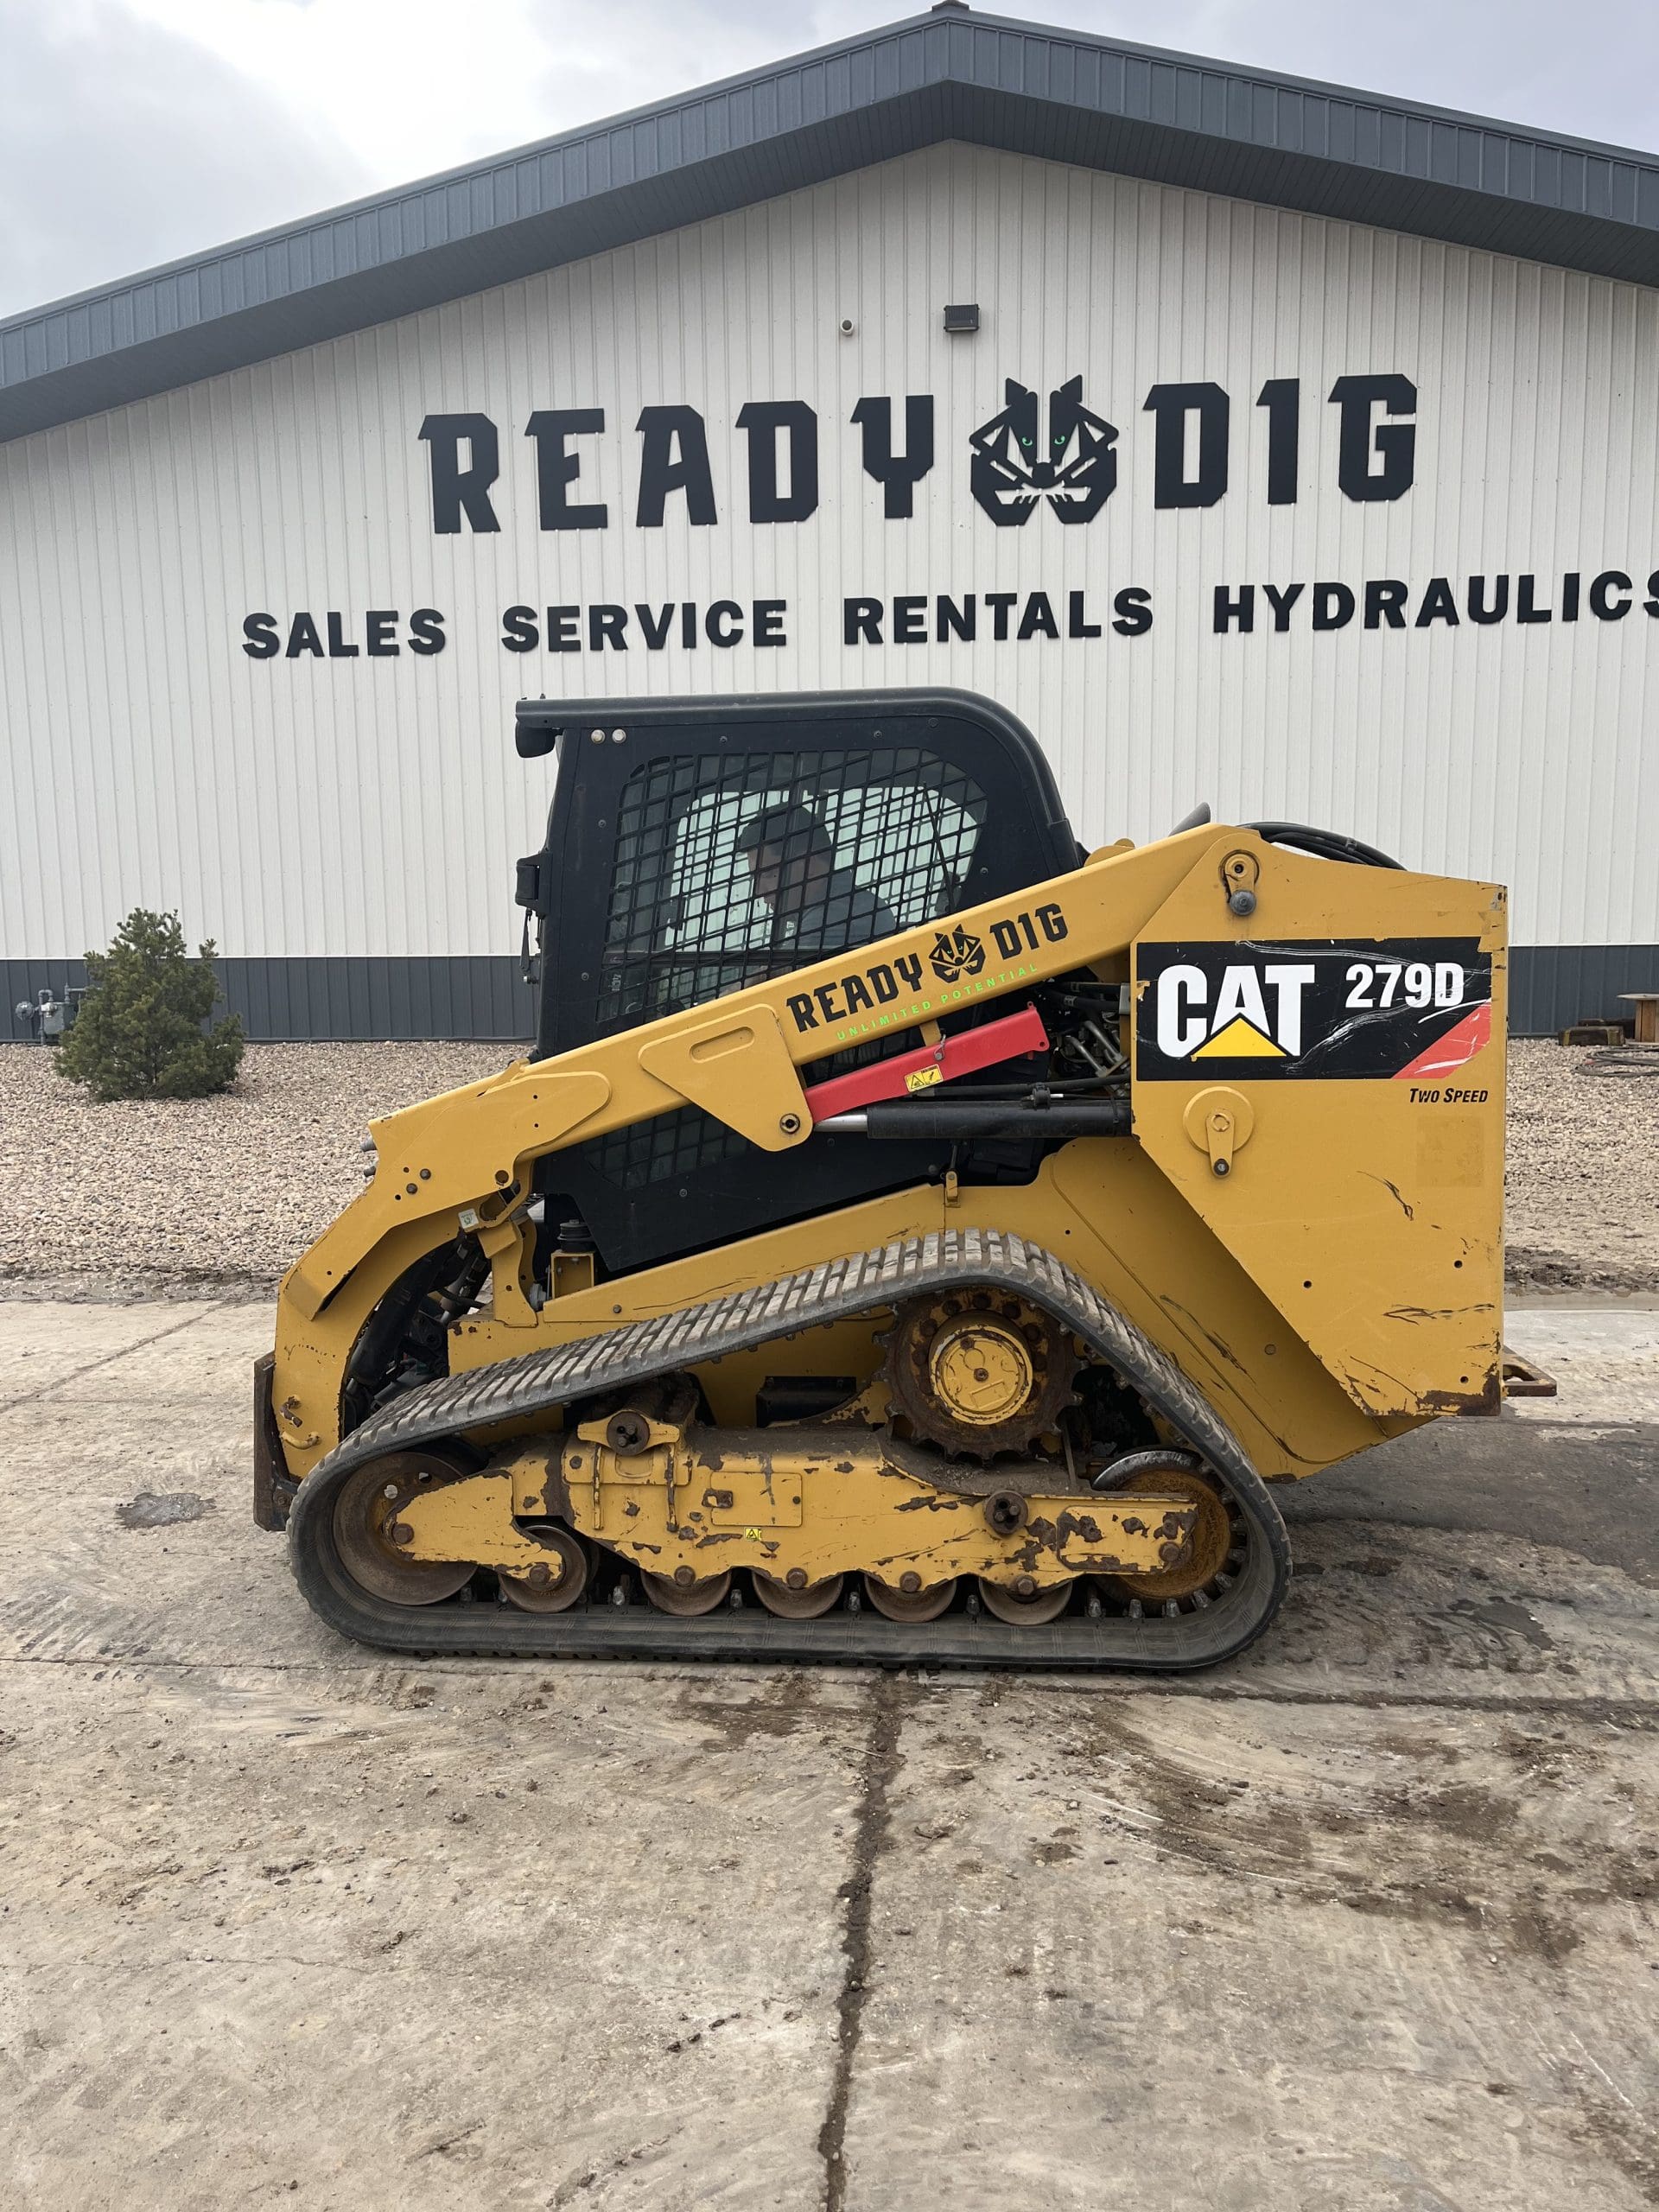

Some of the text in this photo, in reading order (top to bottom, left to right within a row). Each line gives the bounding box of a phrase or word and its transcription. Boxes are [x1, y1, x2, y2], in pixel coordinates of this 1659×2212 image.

[417, 394, 934, 535] READY
[242, 608, 446, 659] SALES
[501, 599, 787, 653] SERVICE
[843, 587, 1154, 645] RENTALS
[786, 953, 923, 1033] READY
[836, 963, 1038, 1040] UNLIMITED POTENTIAL
[1157, 963, 1465, 1058] CAT 279D
